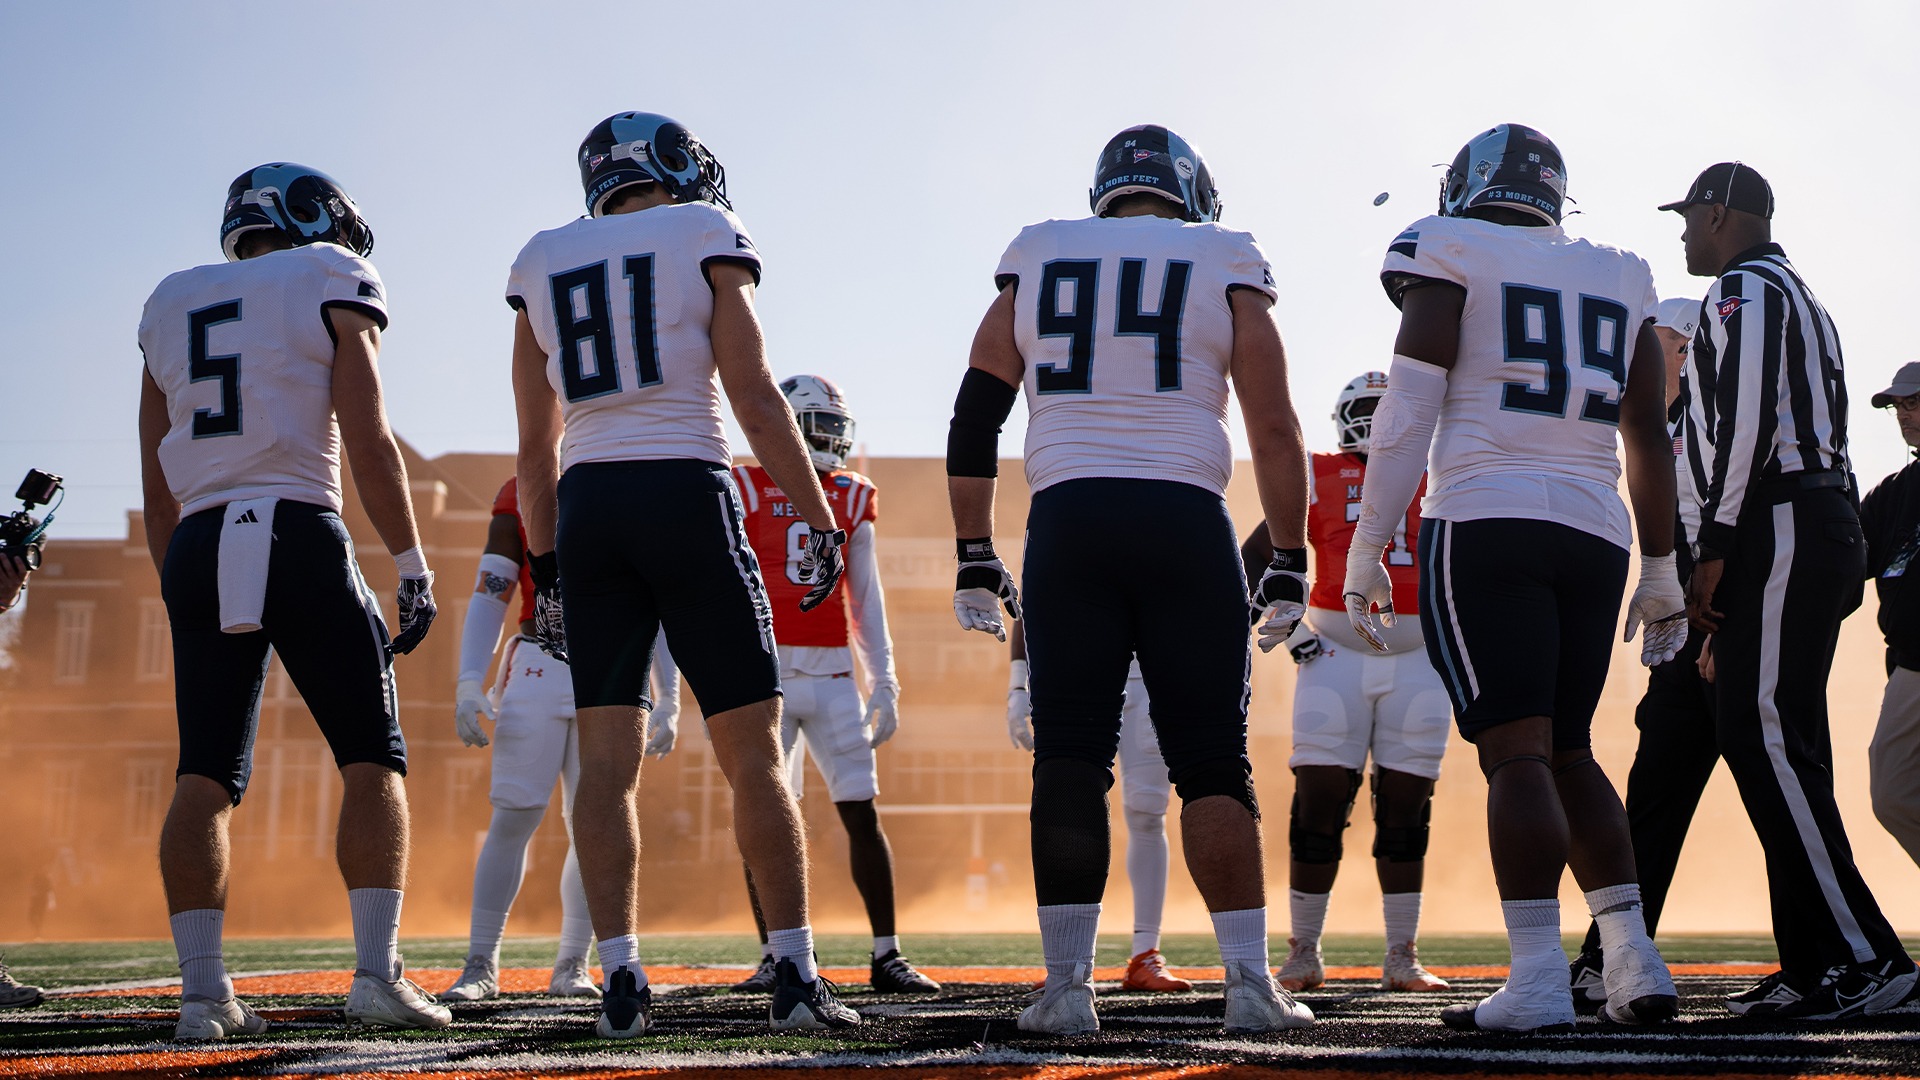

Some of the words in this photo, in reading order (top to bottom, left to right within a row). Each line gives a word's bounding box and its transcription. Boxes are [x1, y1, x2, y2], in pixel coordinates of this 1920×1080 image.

[1528, 153, 1540, 162] 99
[1178, 160, 1192, 173] CAA
[599, 175, 620, 191] FEET
[1105, 175, 1129, 188] MORE
[1132, 174, 1159, 184] FEET
[1488, 190, 1503, 199] #3
[1506, 192, 1533, 203] MORE
[1536, 200, 1555, 213] FEET
[1704, 189, 1713, 200] S
[548, 252, 665, 404] 81
[1035, 256, 1194, 396] 94
[1683, 322, 1693, 332] S
[1499, 281, 1630, 428] 99
[188, 297, 243, 440] 5
